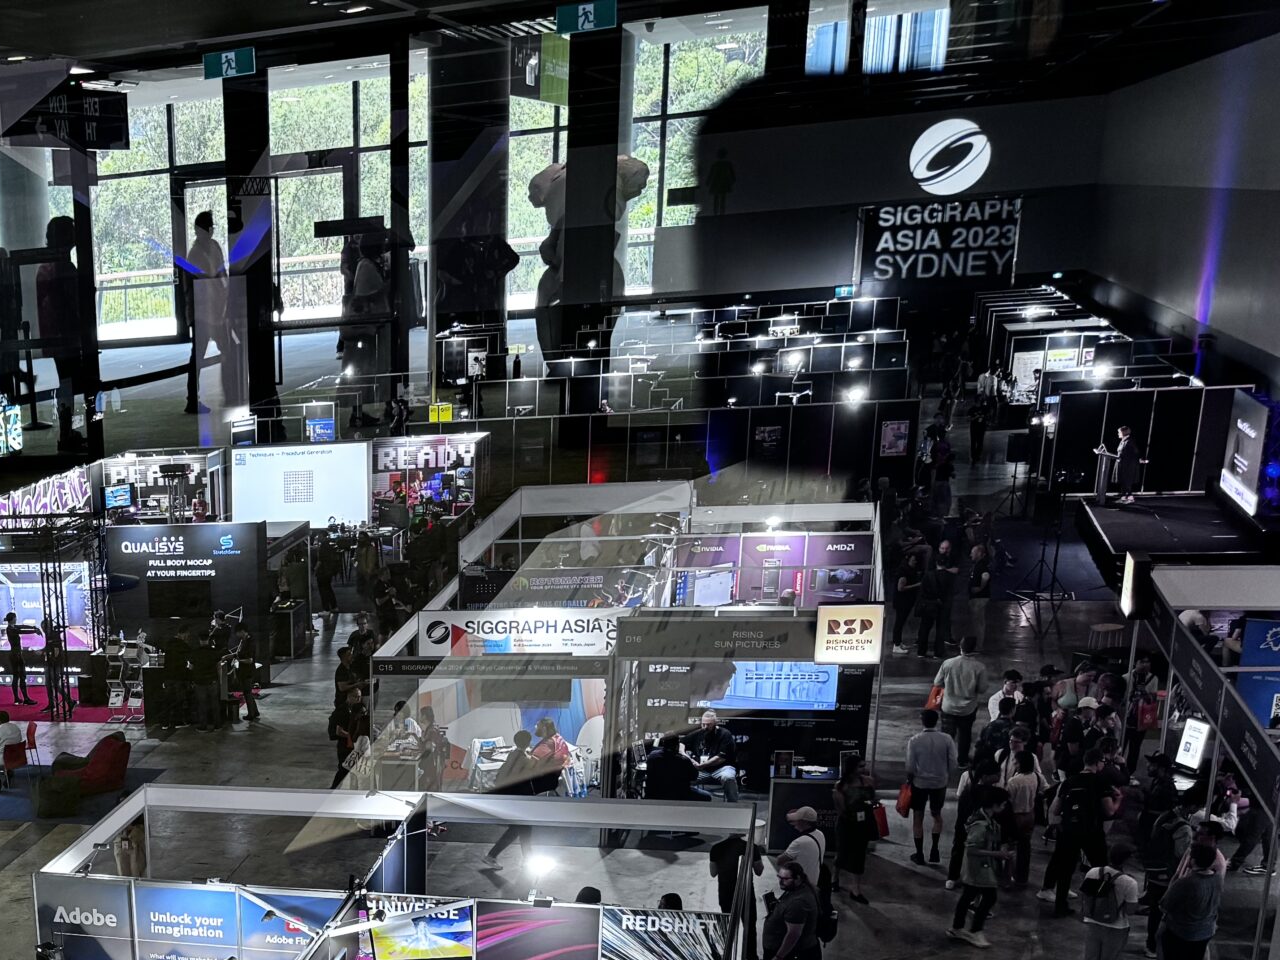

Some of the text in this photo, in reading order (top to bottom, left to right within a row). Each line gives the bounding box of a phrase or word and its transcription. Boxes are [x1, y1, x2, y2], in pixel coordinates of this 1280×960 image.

[878, 200, 1021, 227] SIGGRAPH
[876, 225, 1016, 252] ASIA 2023
[873, 250, 1014, 280] SYDNEY
[377, 444, 475, 470] READY
[465, 619, 603, 634] SIGGRAPH ASIA
[827, 619, 873, 635] RSP
[475, 664, 491, 672] Tokyo
[53, 906, 117, 927] Adobe
[149, 912, 224, 930] Unlock your
[621, 914, 718, 936] REDSHIFT
[150, 923, 224, 939] imagination
[265, 934, 294, 945] Adobe
[165, 953, 176, 960] will
